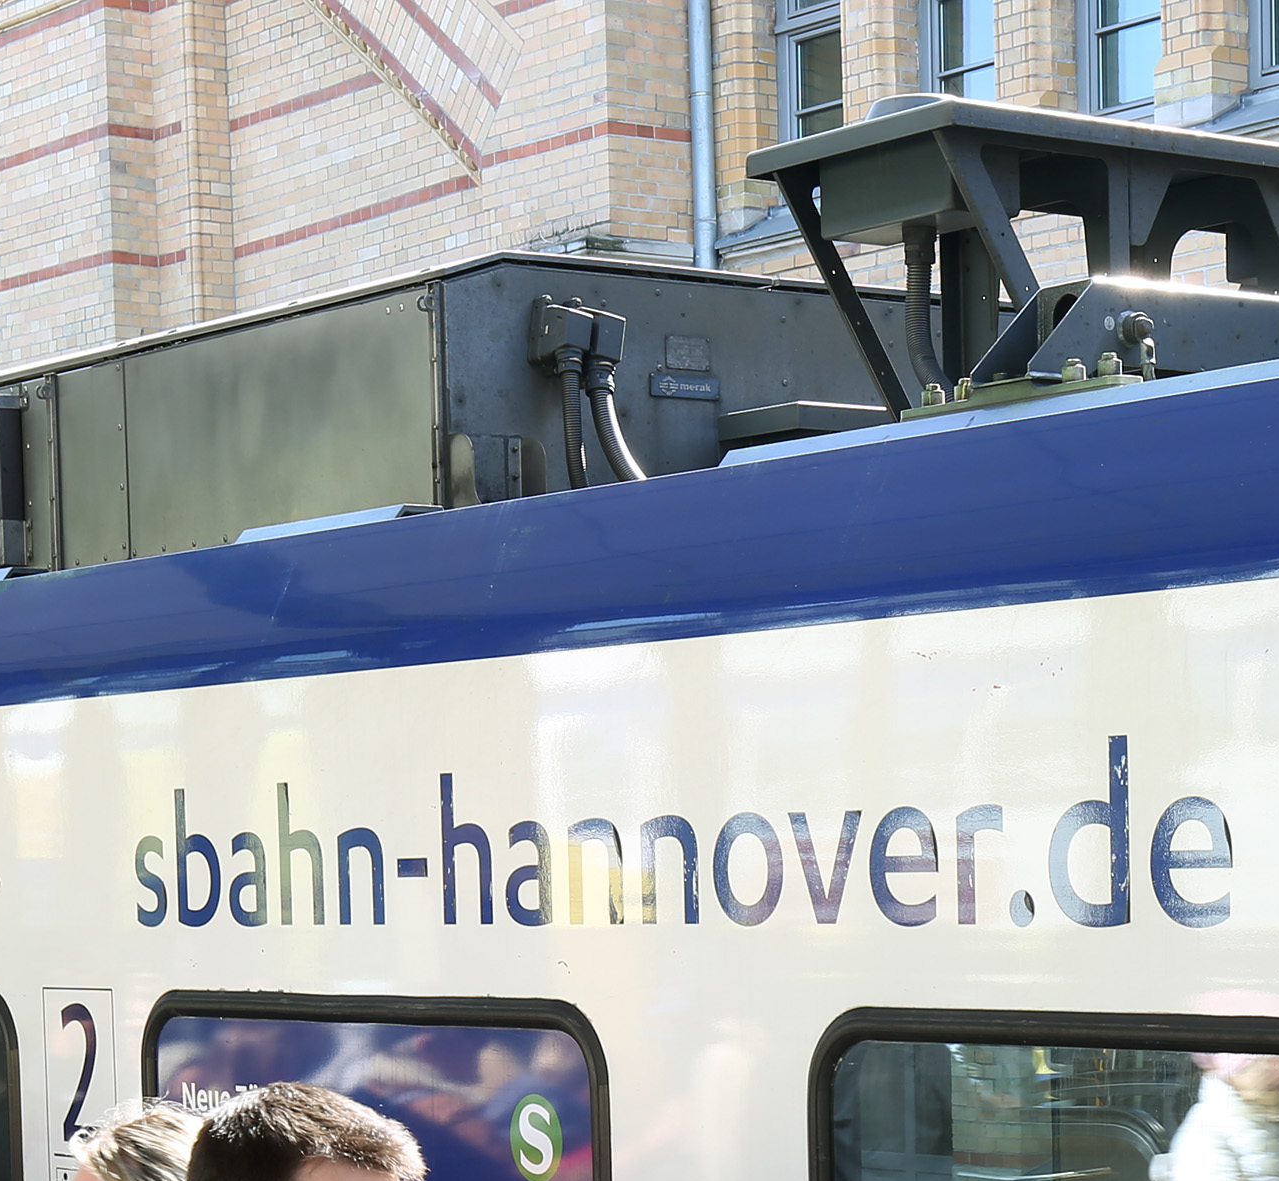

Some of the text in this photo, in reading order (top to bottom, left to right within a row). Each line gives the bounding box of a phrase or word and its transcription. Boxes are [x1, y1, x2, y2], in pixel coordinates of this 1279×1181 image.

[680, 383, 711, 393] merak
[134, 734, 1233, 928] sbahn-hannover.de
[60, 1002, 98, 1142] 2
[518, 1103, 554, 1175] S
